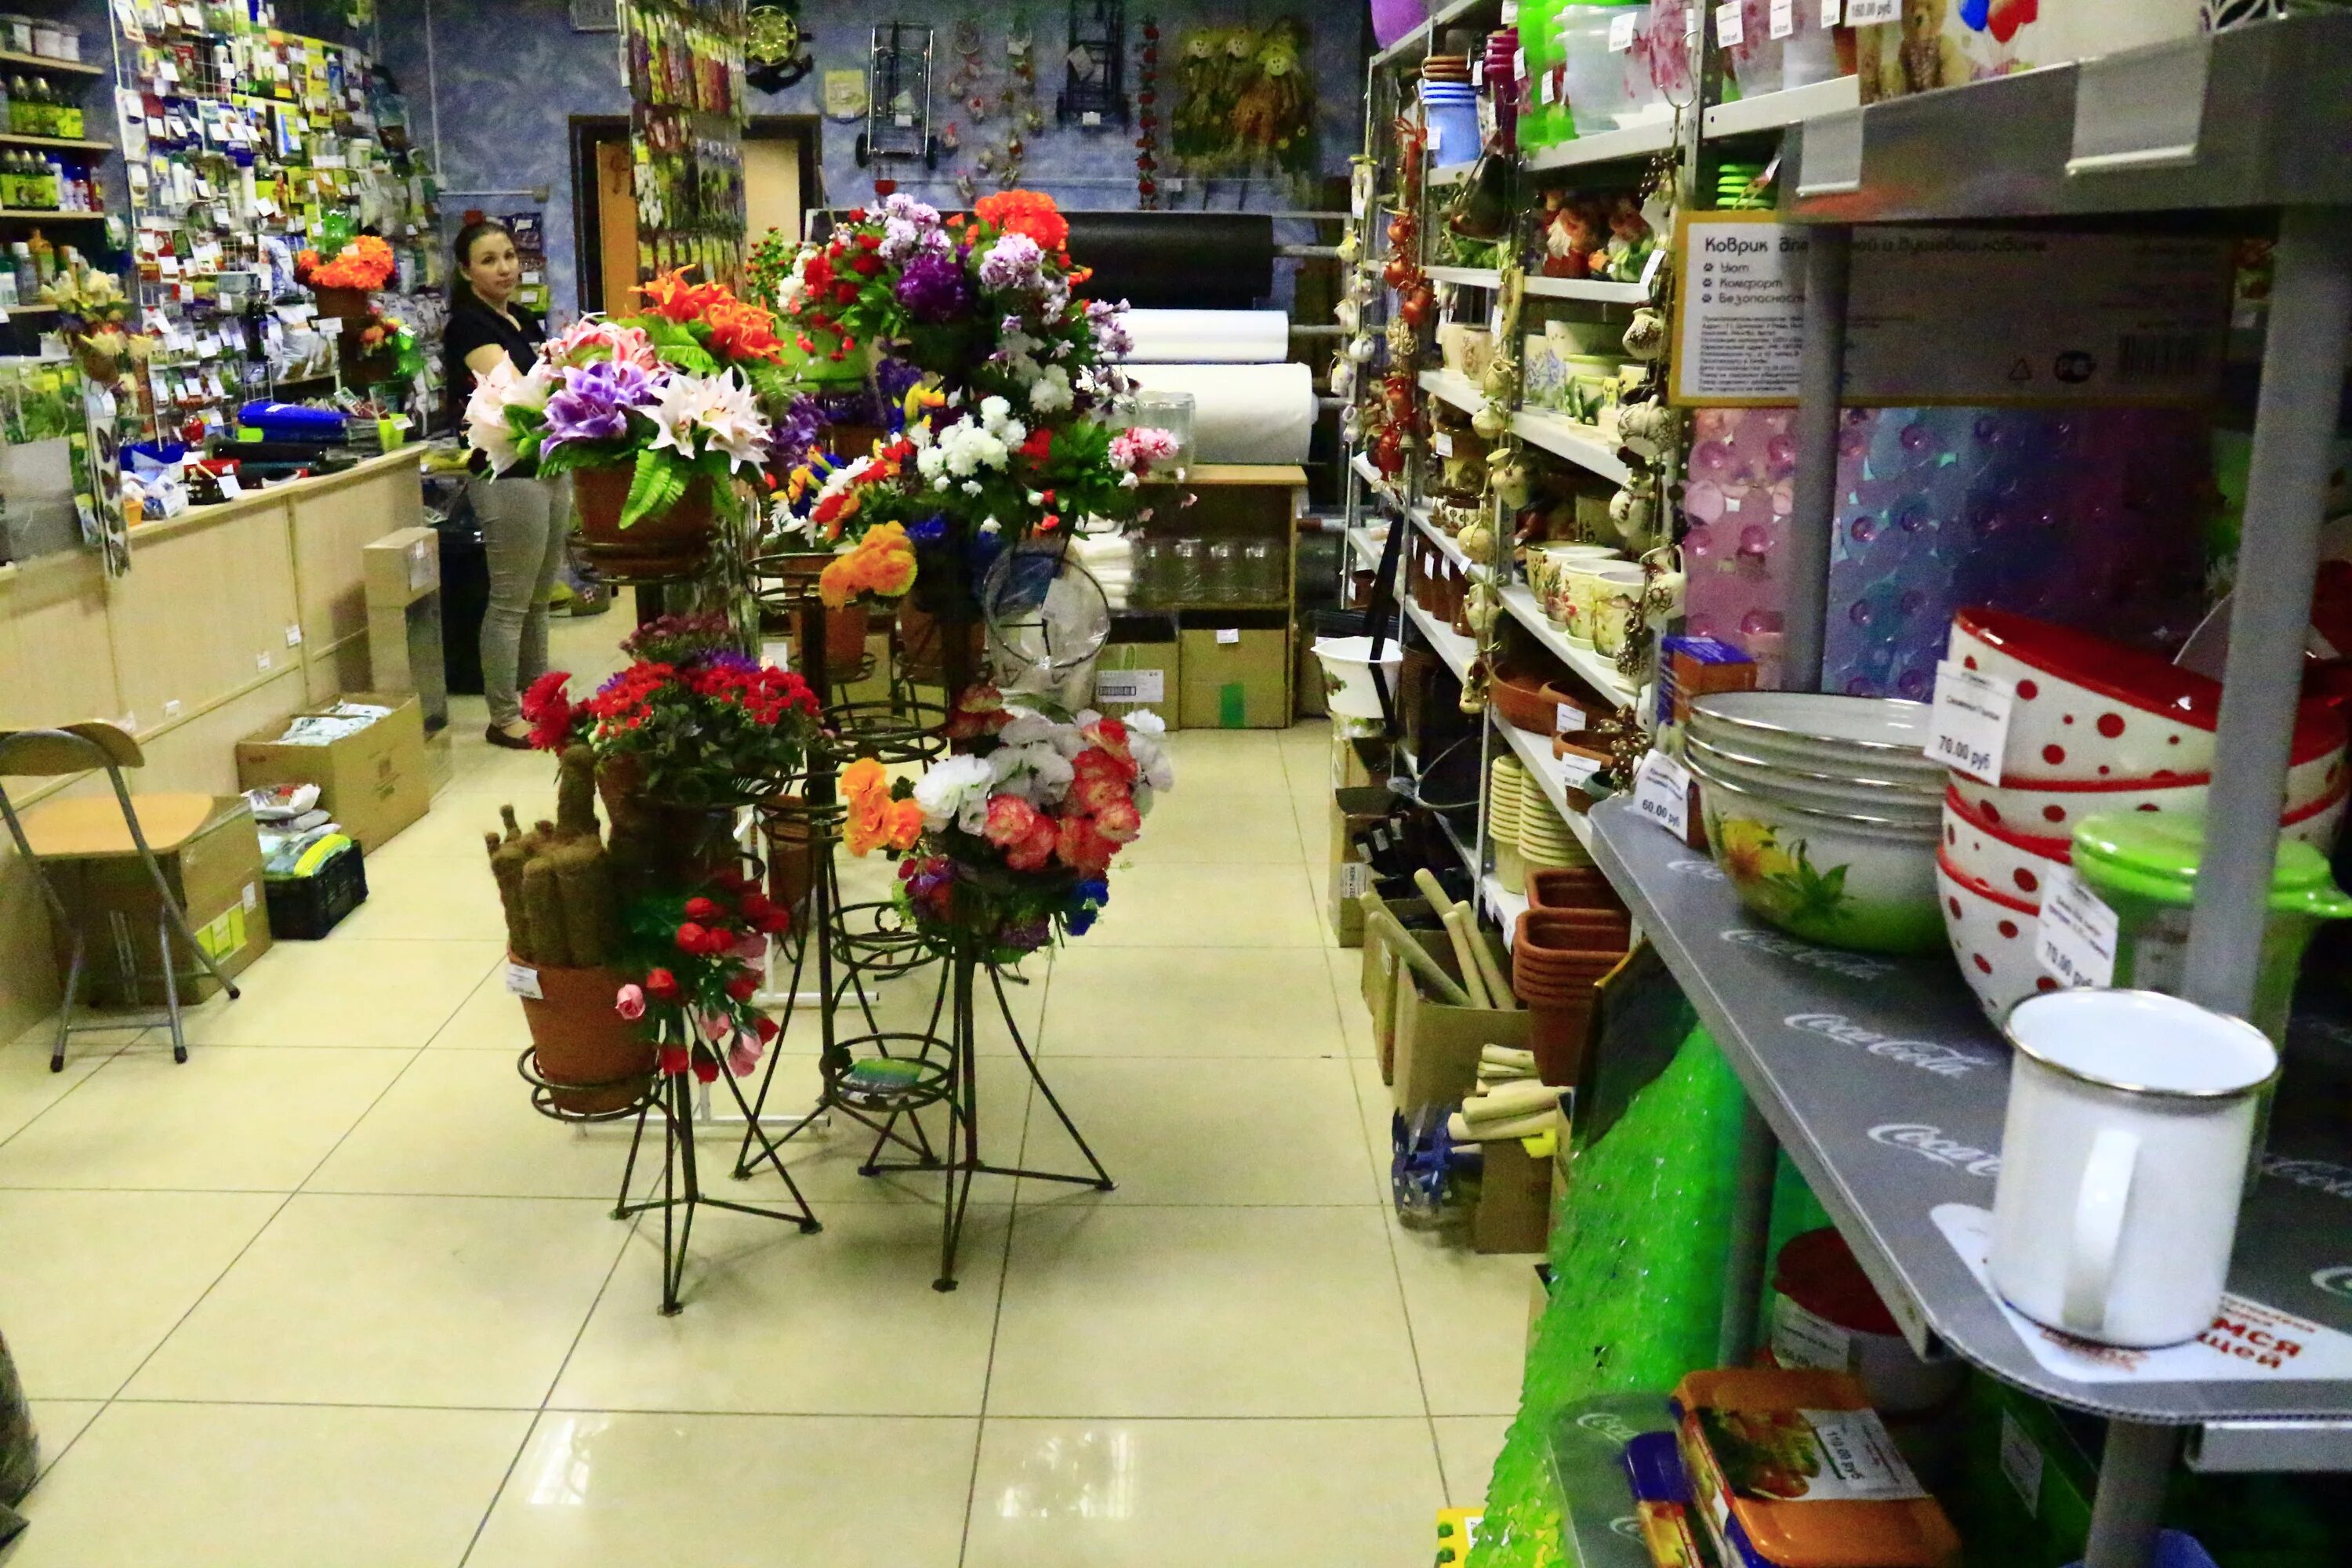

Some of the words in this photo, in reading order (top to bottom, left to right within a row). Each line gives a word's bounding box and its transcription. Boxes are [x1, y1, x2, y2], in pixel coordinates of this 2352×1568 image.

[1704, 236, 1769, 256] Коврик
[1720, 263, 1750, 274] Уют
[1719, 278, 1784, 291] Комфорт
[1719, 292, 1806, 307] Безопасност
[1939, 735, 1969, 760] 70.00
[1971, 750, 1991, 771] руб
[1642, 798, 1668, 819] 60.00
